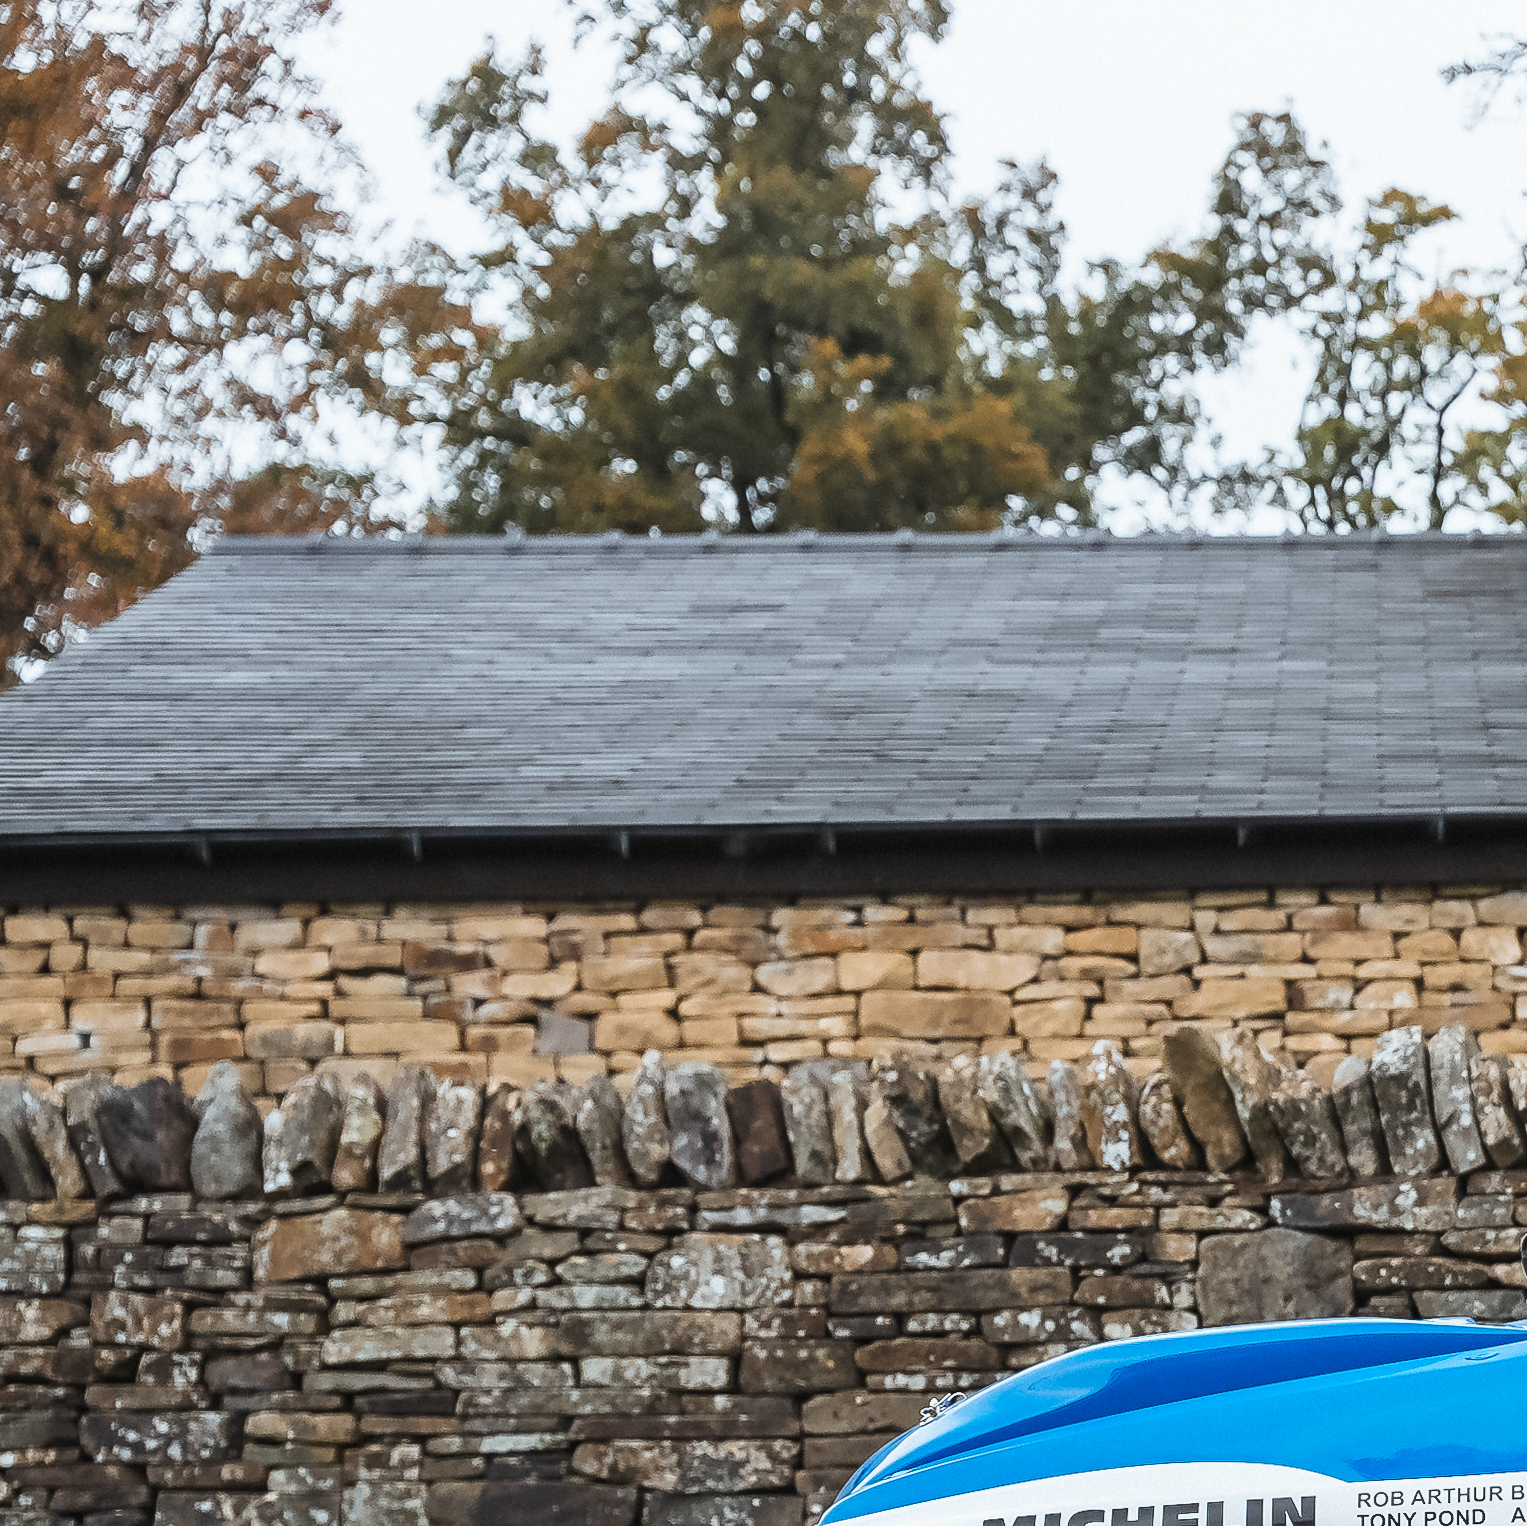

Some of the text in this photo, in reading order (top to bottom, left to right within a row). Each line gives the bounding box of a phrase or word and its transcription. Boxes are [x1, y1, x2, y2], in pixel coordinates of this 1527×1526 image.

[1357, 1490, 1405, 1508] ROB
[1411, 1486, 1503, 1506] ARTHUR
[1424, 1508, 1486, 1526] POND
